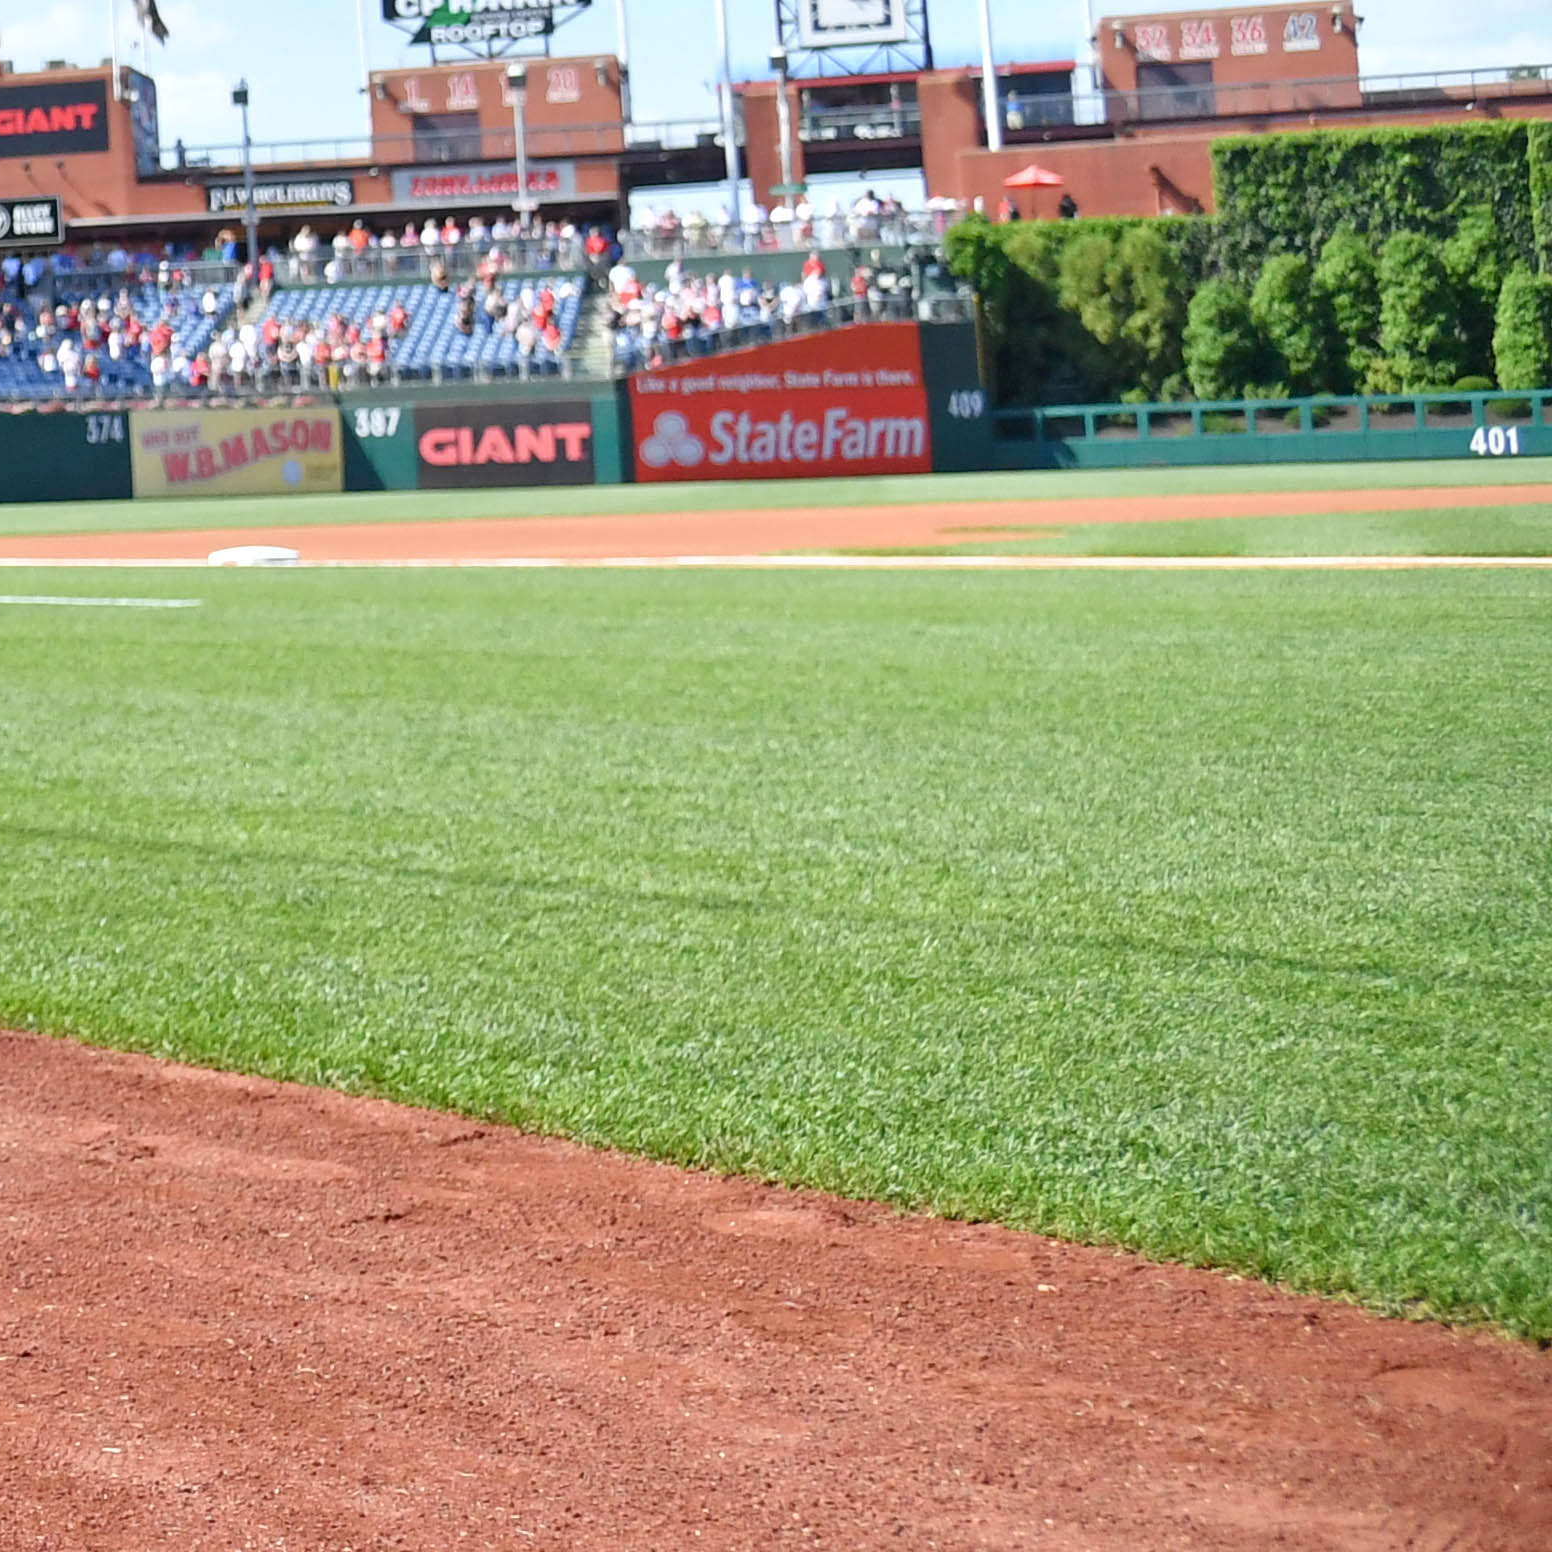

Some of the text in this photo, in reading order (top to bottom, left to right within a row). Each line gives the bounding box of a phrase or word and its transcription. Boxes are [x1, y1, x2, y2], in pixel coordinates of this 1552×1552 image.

[430, 19, 545, 43] ROOFTOP
[1231, 16, 1264, 44] 36
[784, 369, 820, 389] State
[823, 367, 859, 387] Farm
[86, 416, 124, 443] 374
[1469, 426, 1520, 456] 401
[419, 423, 592, 466] GIANT
